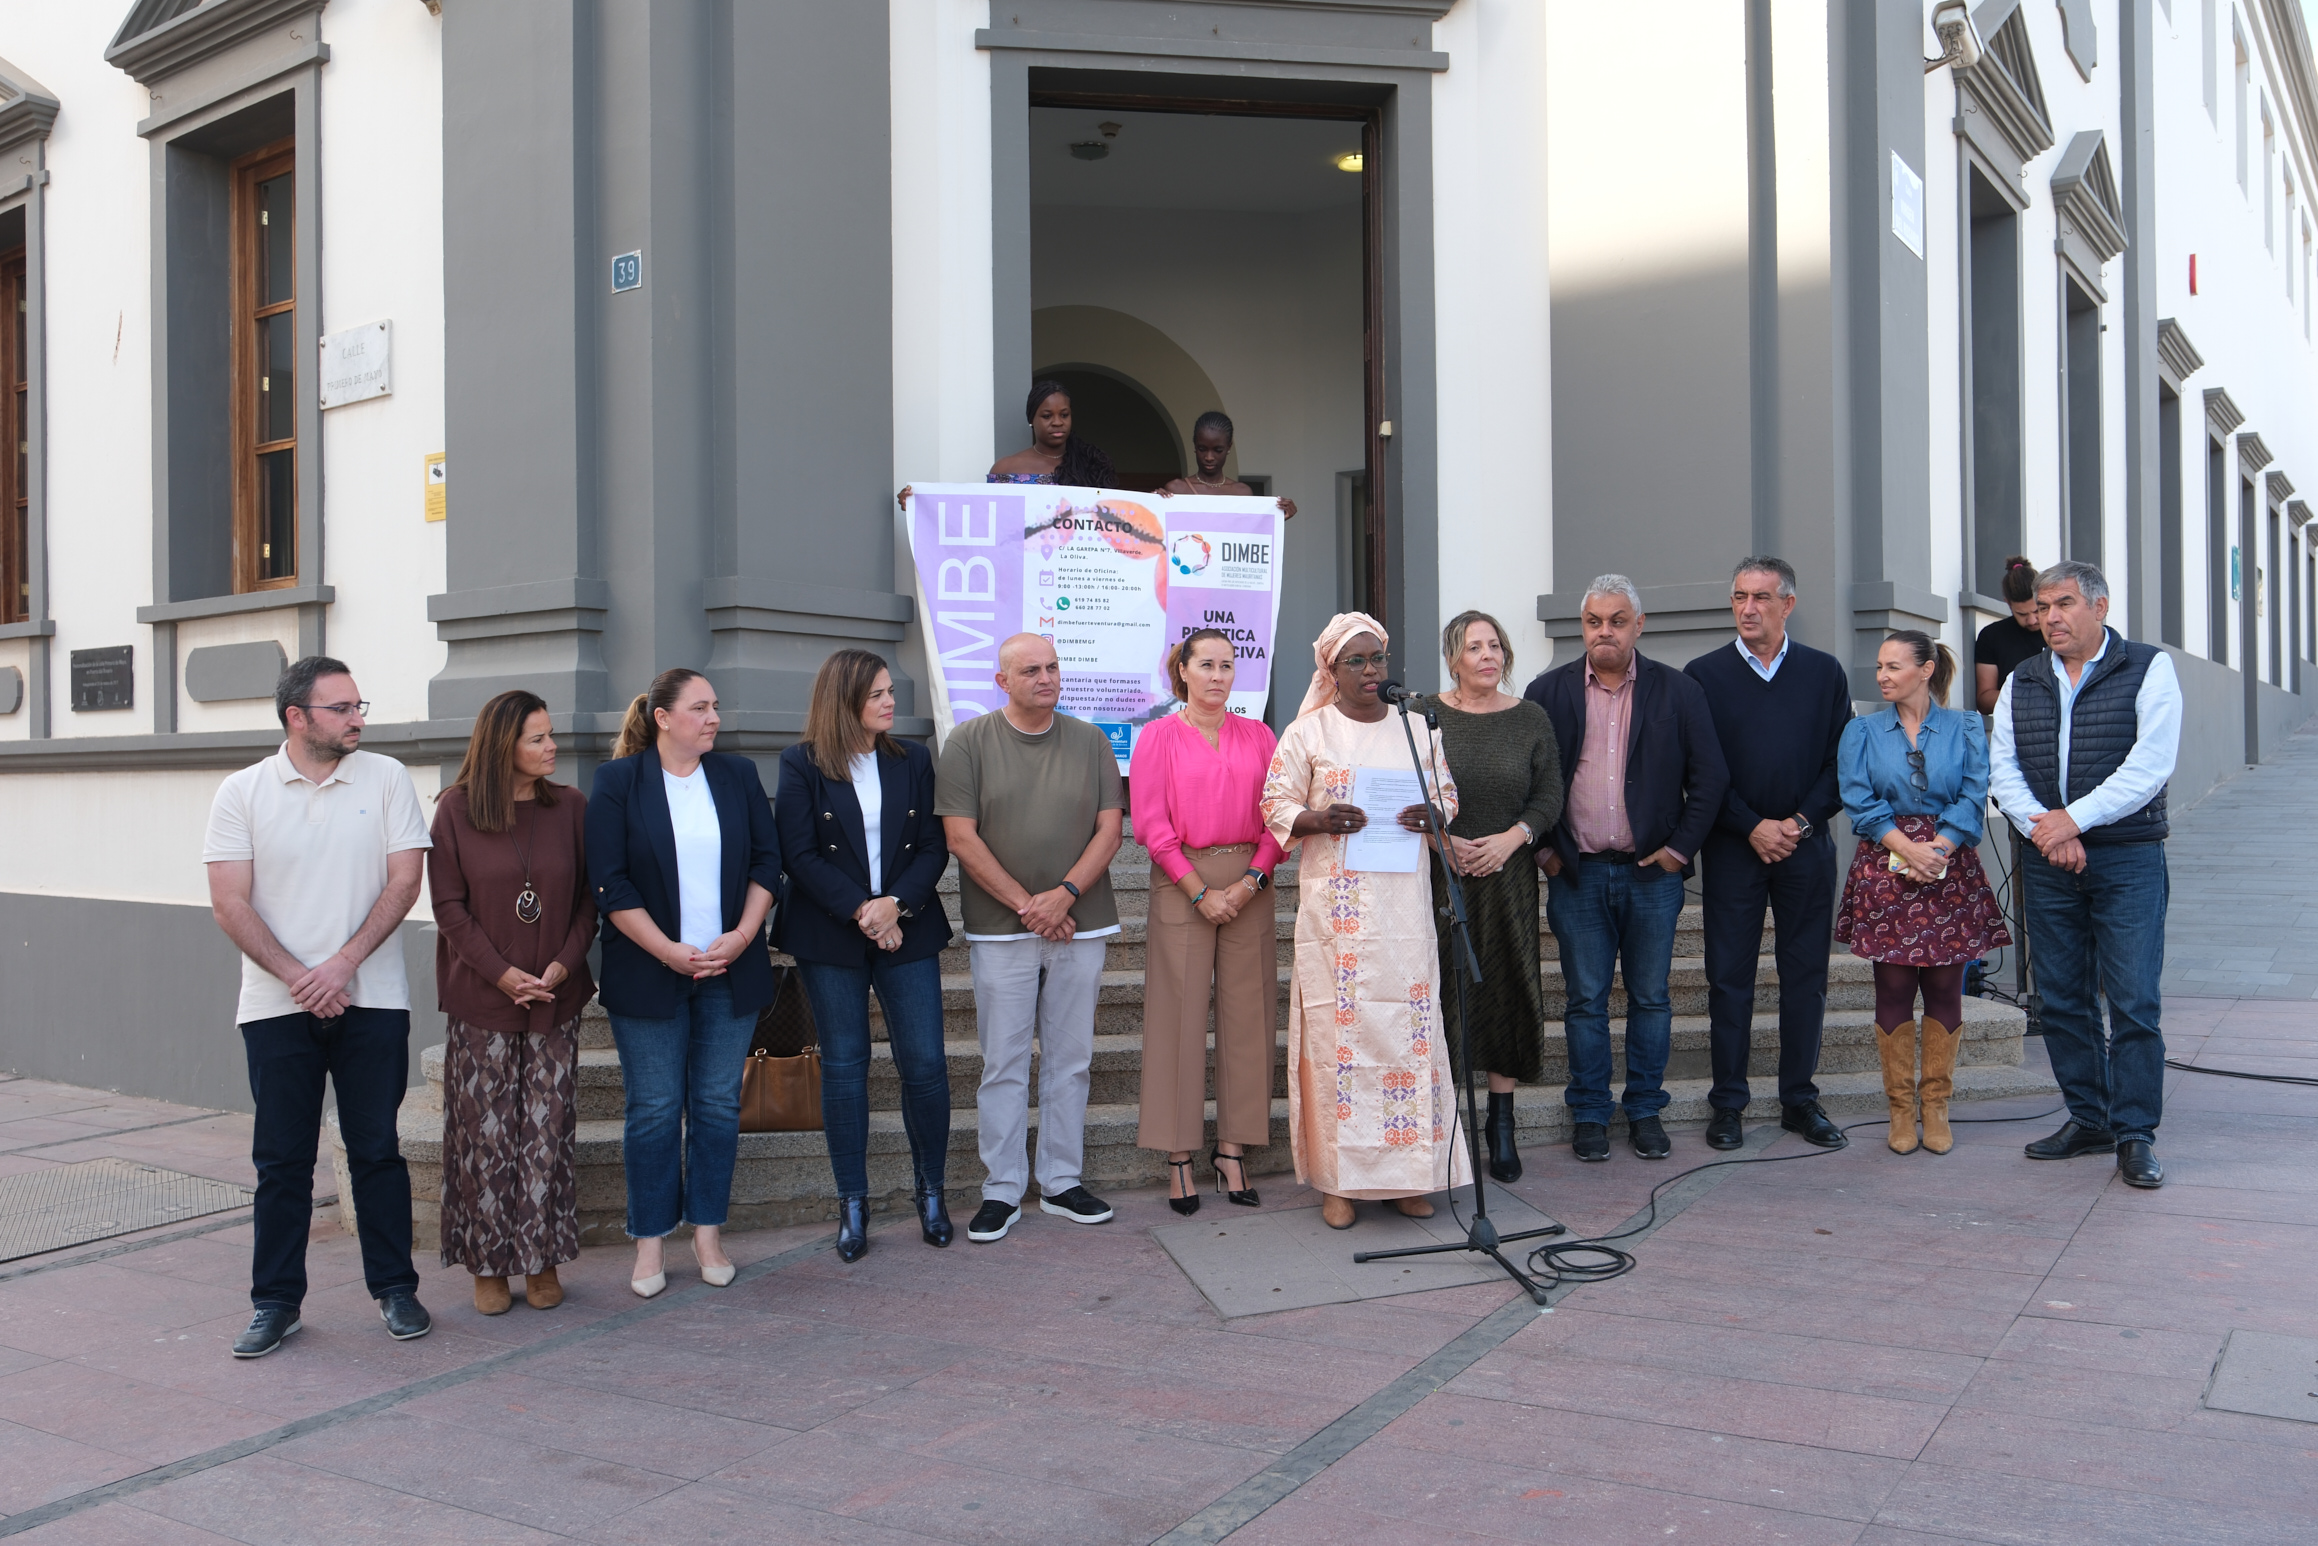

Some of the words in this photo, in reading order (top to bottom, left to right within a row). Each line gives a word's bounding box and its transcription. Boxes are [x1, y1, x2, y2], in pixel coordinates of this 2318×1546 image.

[618, 260, 634, 284] 39
[342, 342, 365, 360] CALLE
[354, 374, 362, 385] DE
[1052, 518, 1133, 533] CONTACTO
[1222, 542, 1269, 564] DIMBE
[1204, 610, 1235, 624] UNA
